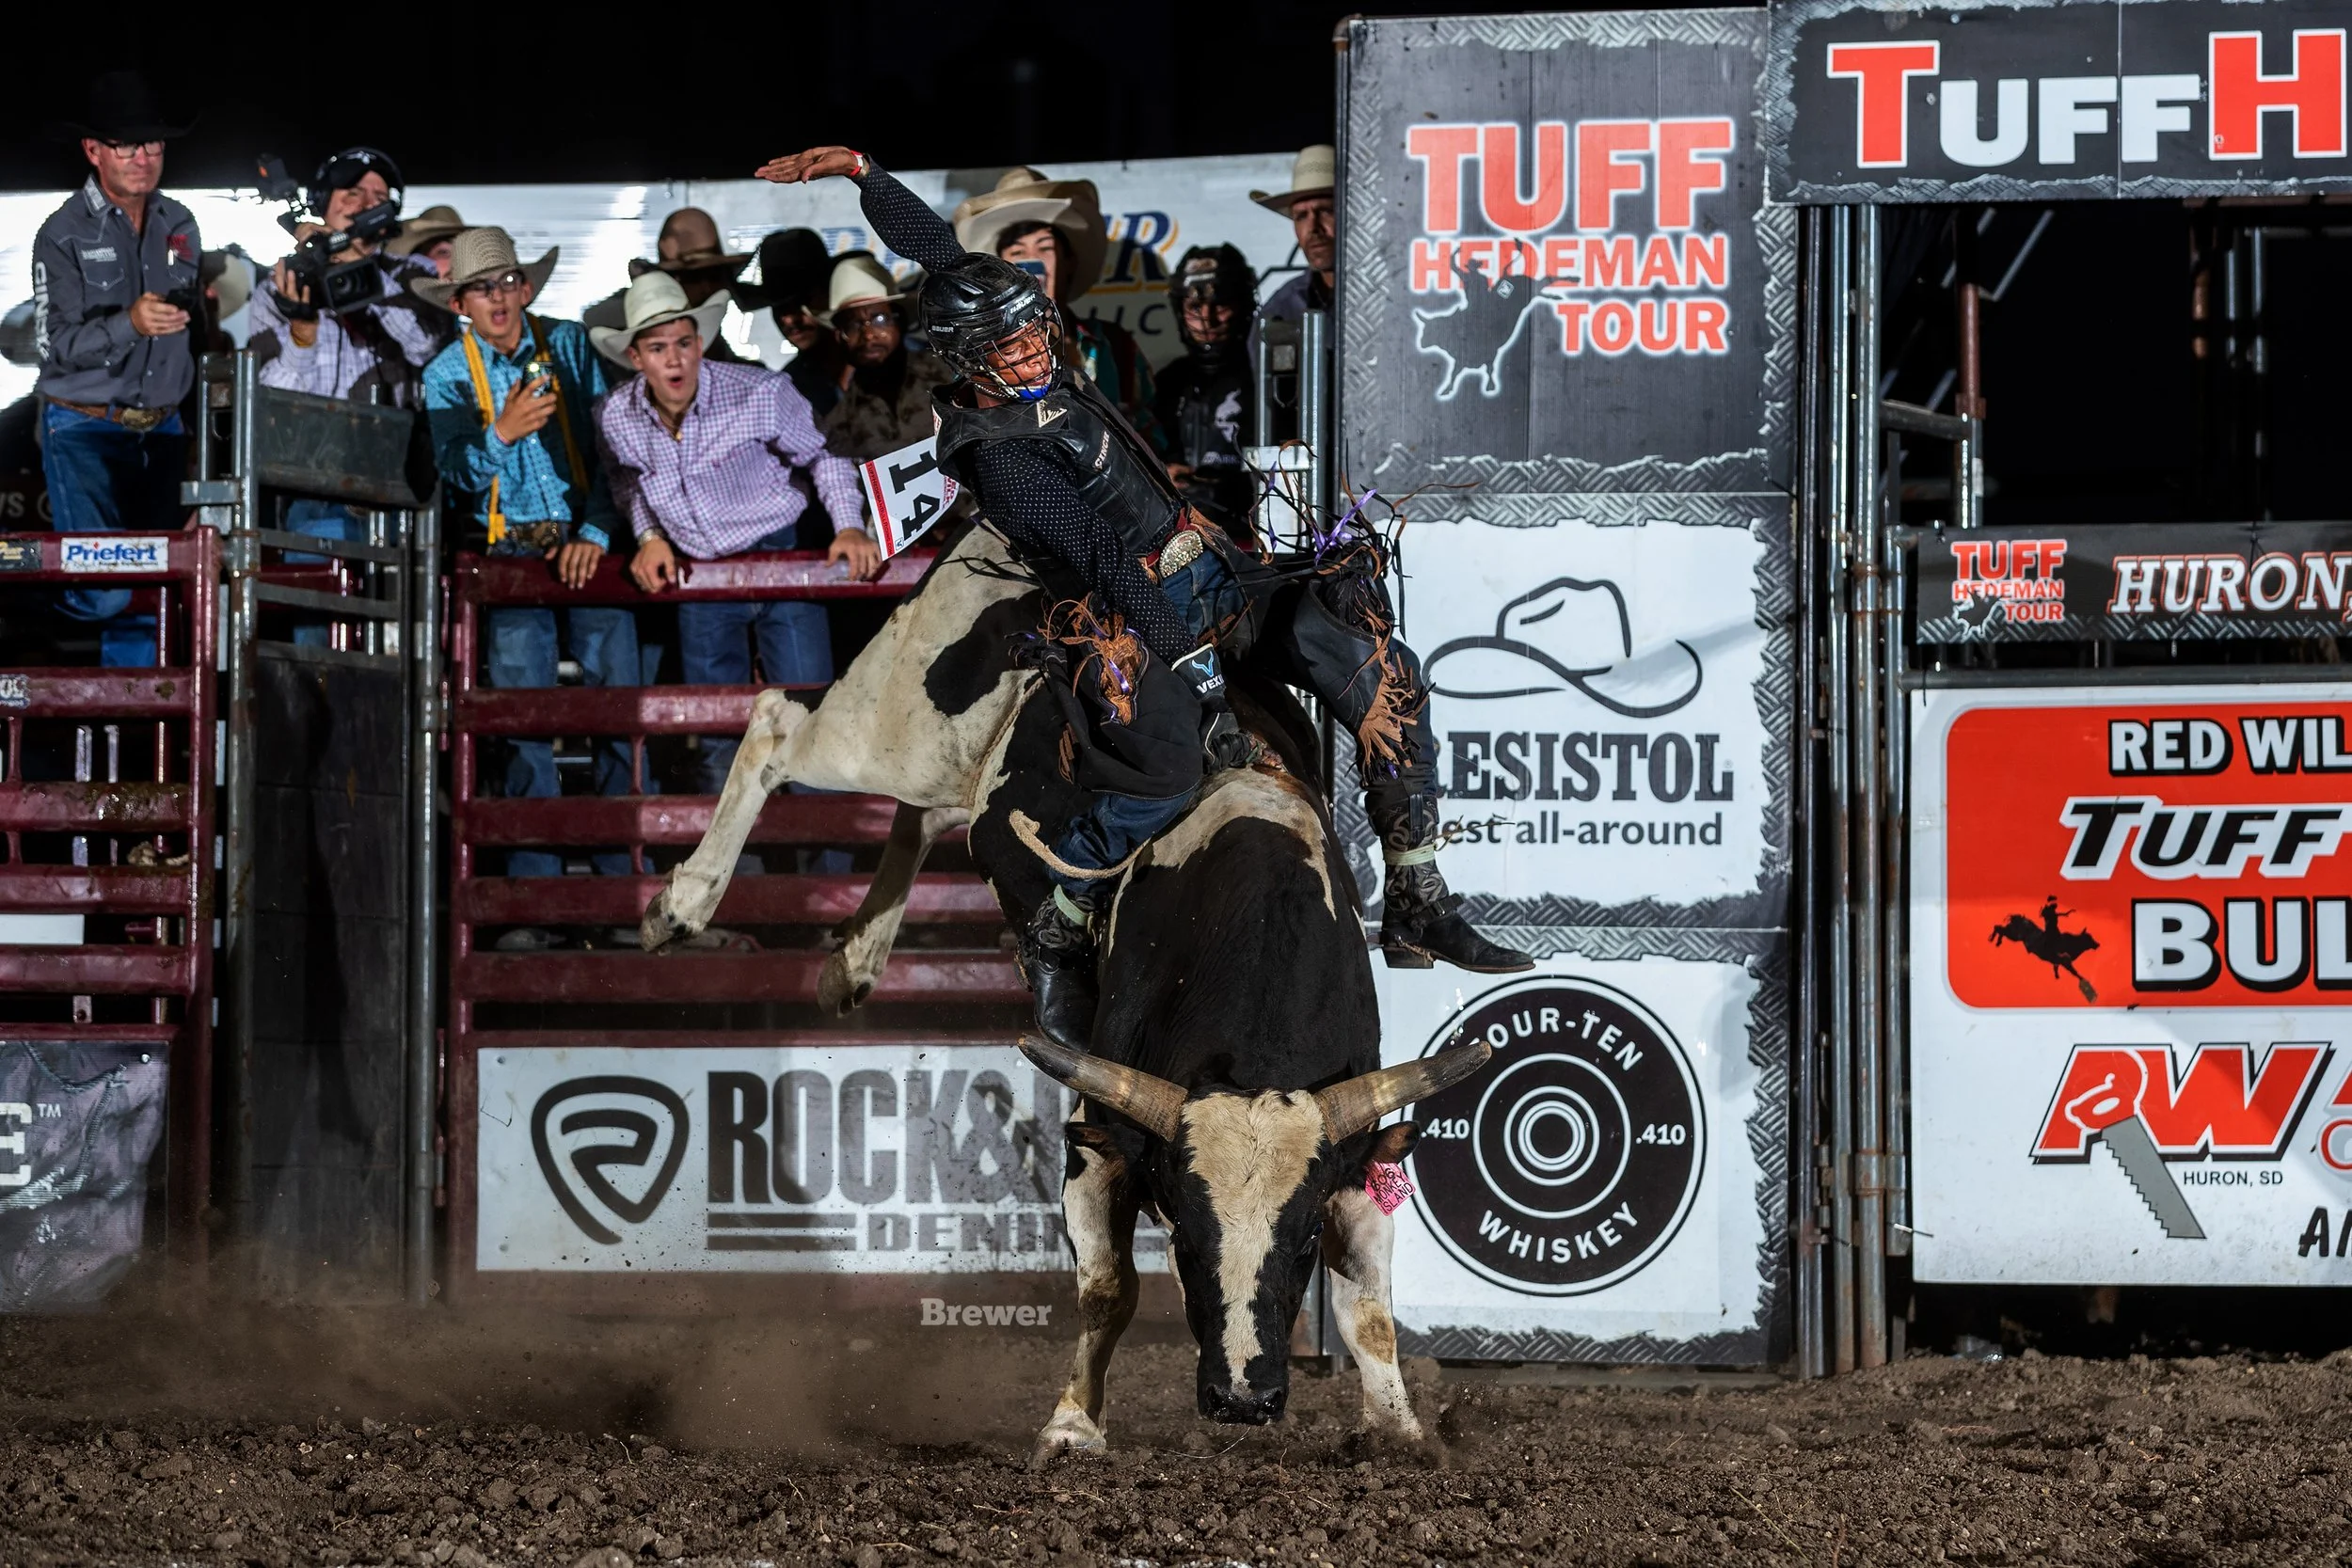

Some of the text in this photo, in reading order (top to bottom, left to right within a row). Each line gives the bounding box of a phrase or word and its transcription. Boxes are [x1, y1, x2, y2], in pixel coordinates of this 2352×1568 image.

[1408, 119, 1732, 232] TUFF
[1411, 236, 1728, 291] HEDEMAN
[931, 325, 954, 333] BAUER
[1557, 300, 1728, 355] TOUR
[1094, 431, 1110, 469] CINCH
[888, 451, 940, 541] 14
[67, 542, 157, 562] Priefert
[1951, 539, 2067, 580] TUFF
[1952, 579, 2064, 601] HEDEMAN
[2005, 602, 2064, 623] TOUR
[2108, 719, 2233, 777] RED
[1441, 811, 1723, 845] est all-around
[2063, 799, 2347, 875] TUFF
[1470, 1007, 1643, 1070] OUR-TEN
[1421, 1118, 1470, 1139] .410
[1636, 1123, 1686, 1145] .410
[1374, 1172, 1406, 1205] MONKEY
[2183, 1170, 2283, 1187] HURON, SD
[1381, 1182, 1413, 1213] ISLAND
[1478, 1201, 1638, 1263] WHISKEY
